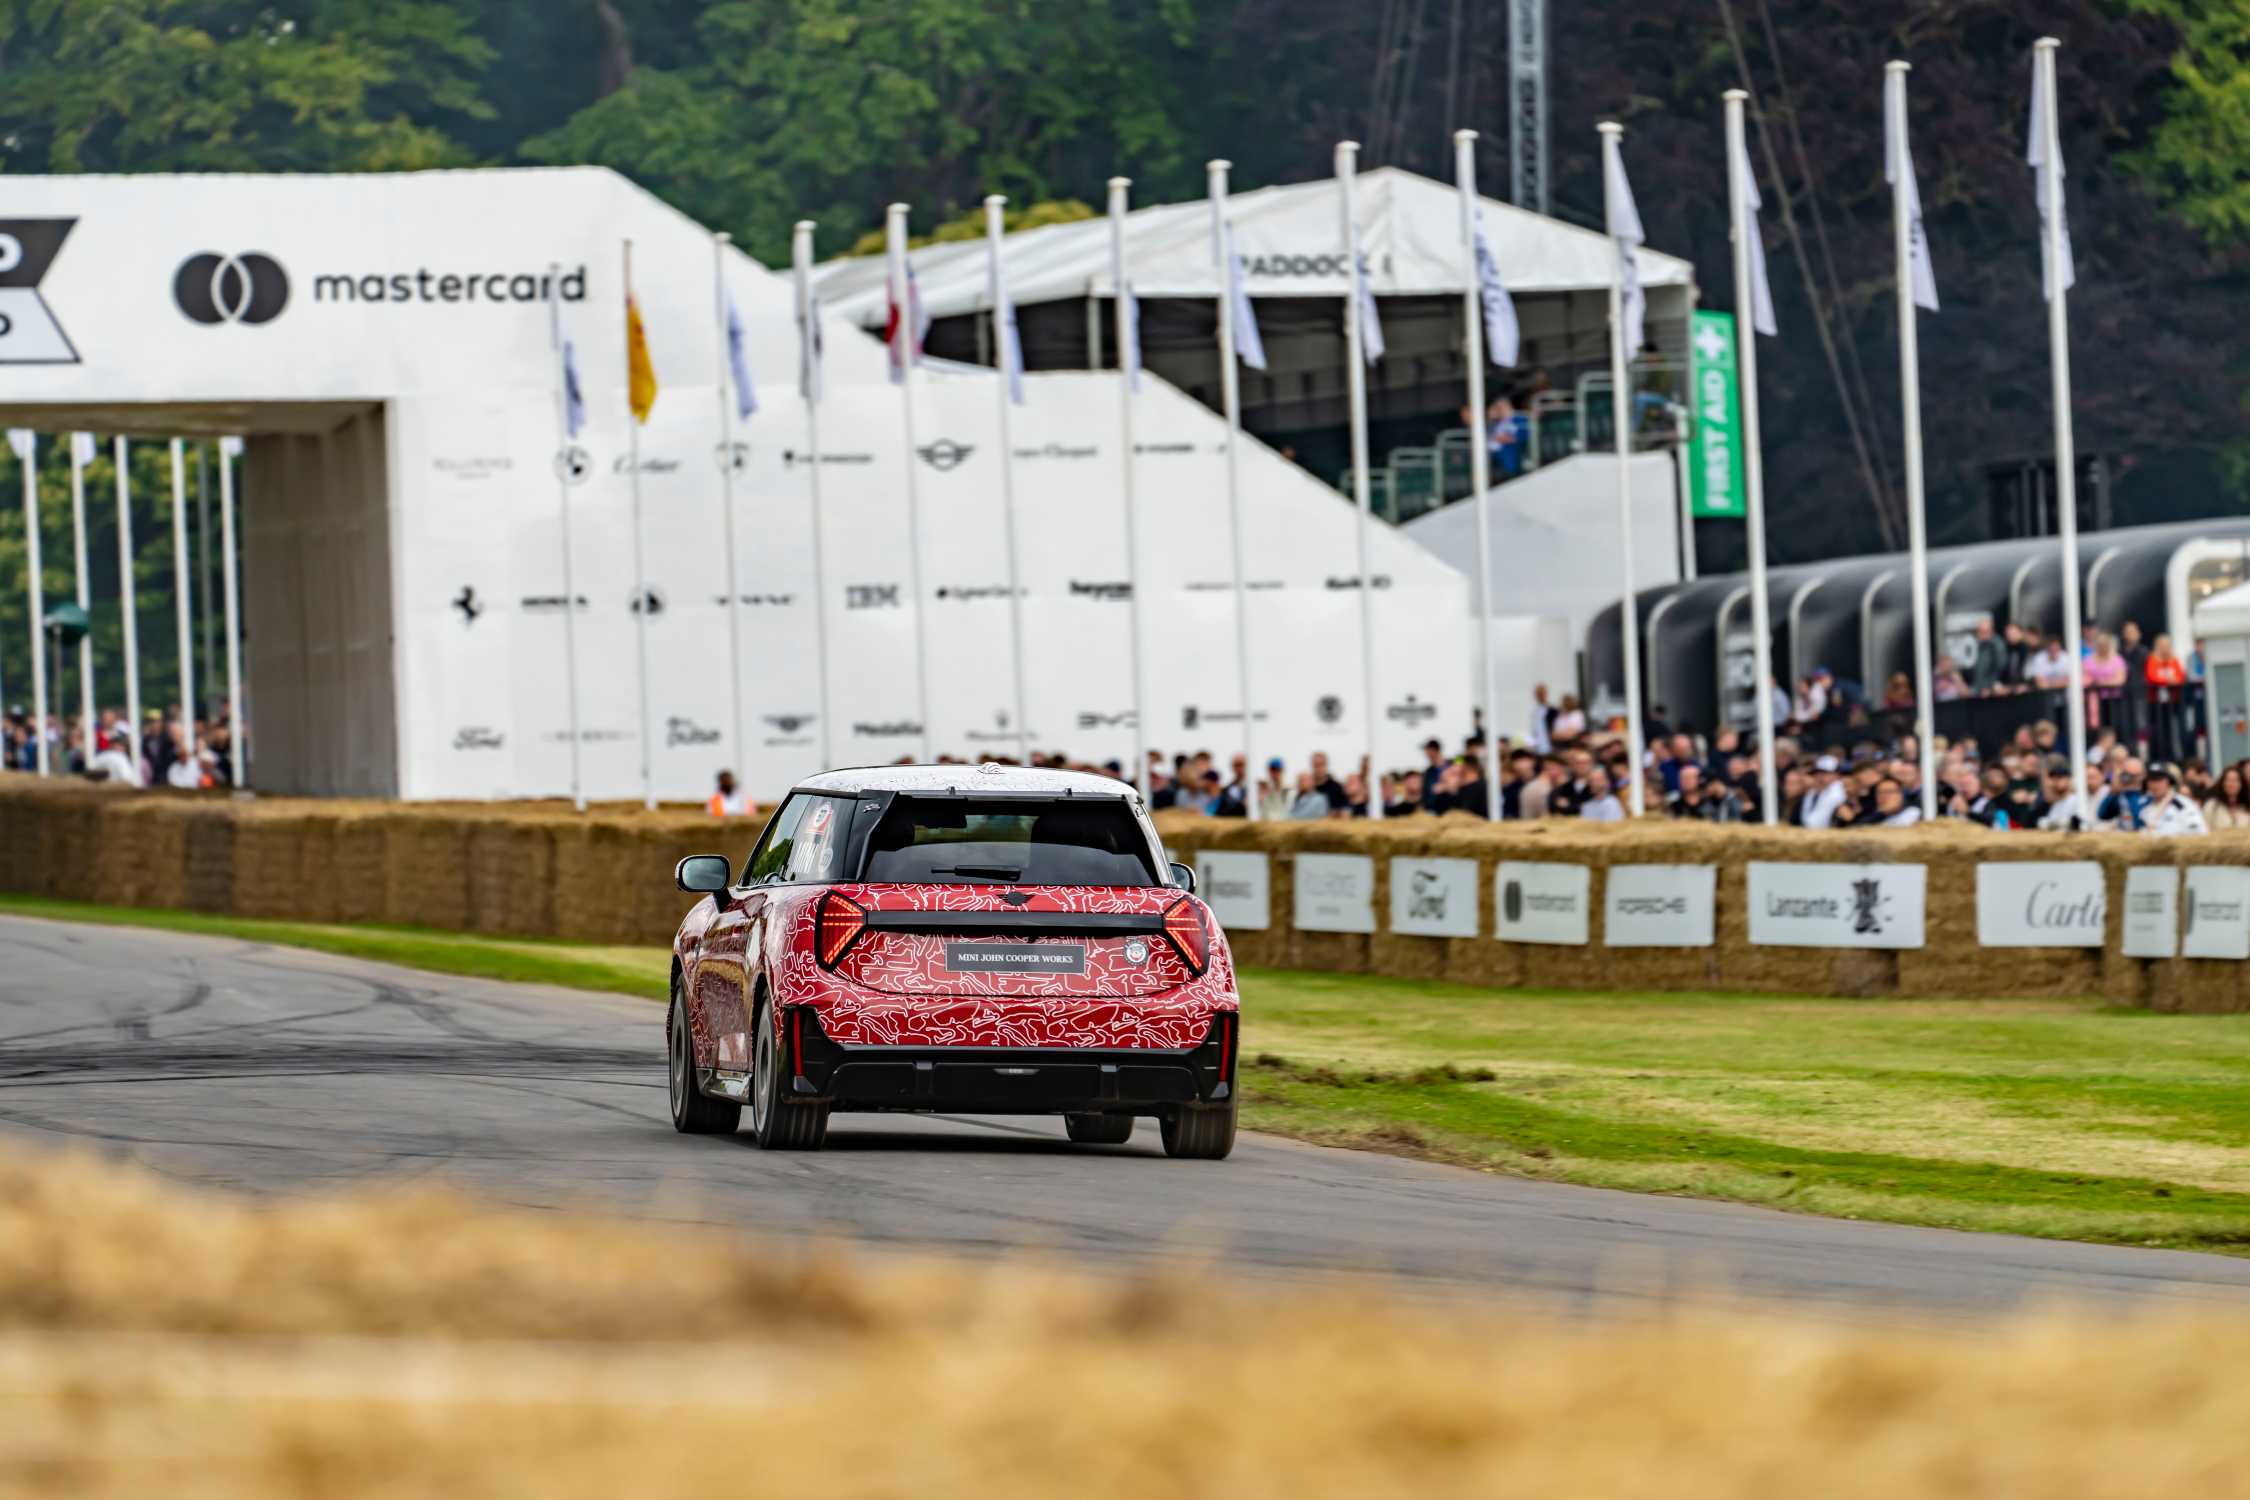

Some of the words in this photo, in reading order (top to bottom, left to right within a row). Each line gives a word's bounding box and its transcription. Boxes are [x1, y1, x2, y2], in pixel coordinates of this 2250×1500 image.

[314, 265, 587, 302] mastercard
[1704, 369, 1728, 424] AID
[1704, 425, 1732, 510] FIRST
[846, 584, 900, 610] IBM
[958, 953, 979, 962] MINI
[980, 953, 1004, 962] JOHN
[1005, 954, 1040, 963] COOPER
[1041, 955, 1073, 963] WORKS
